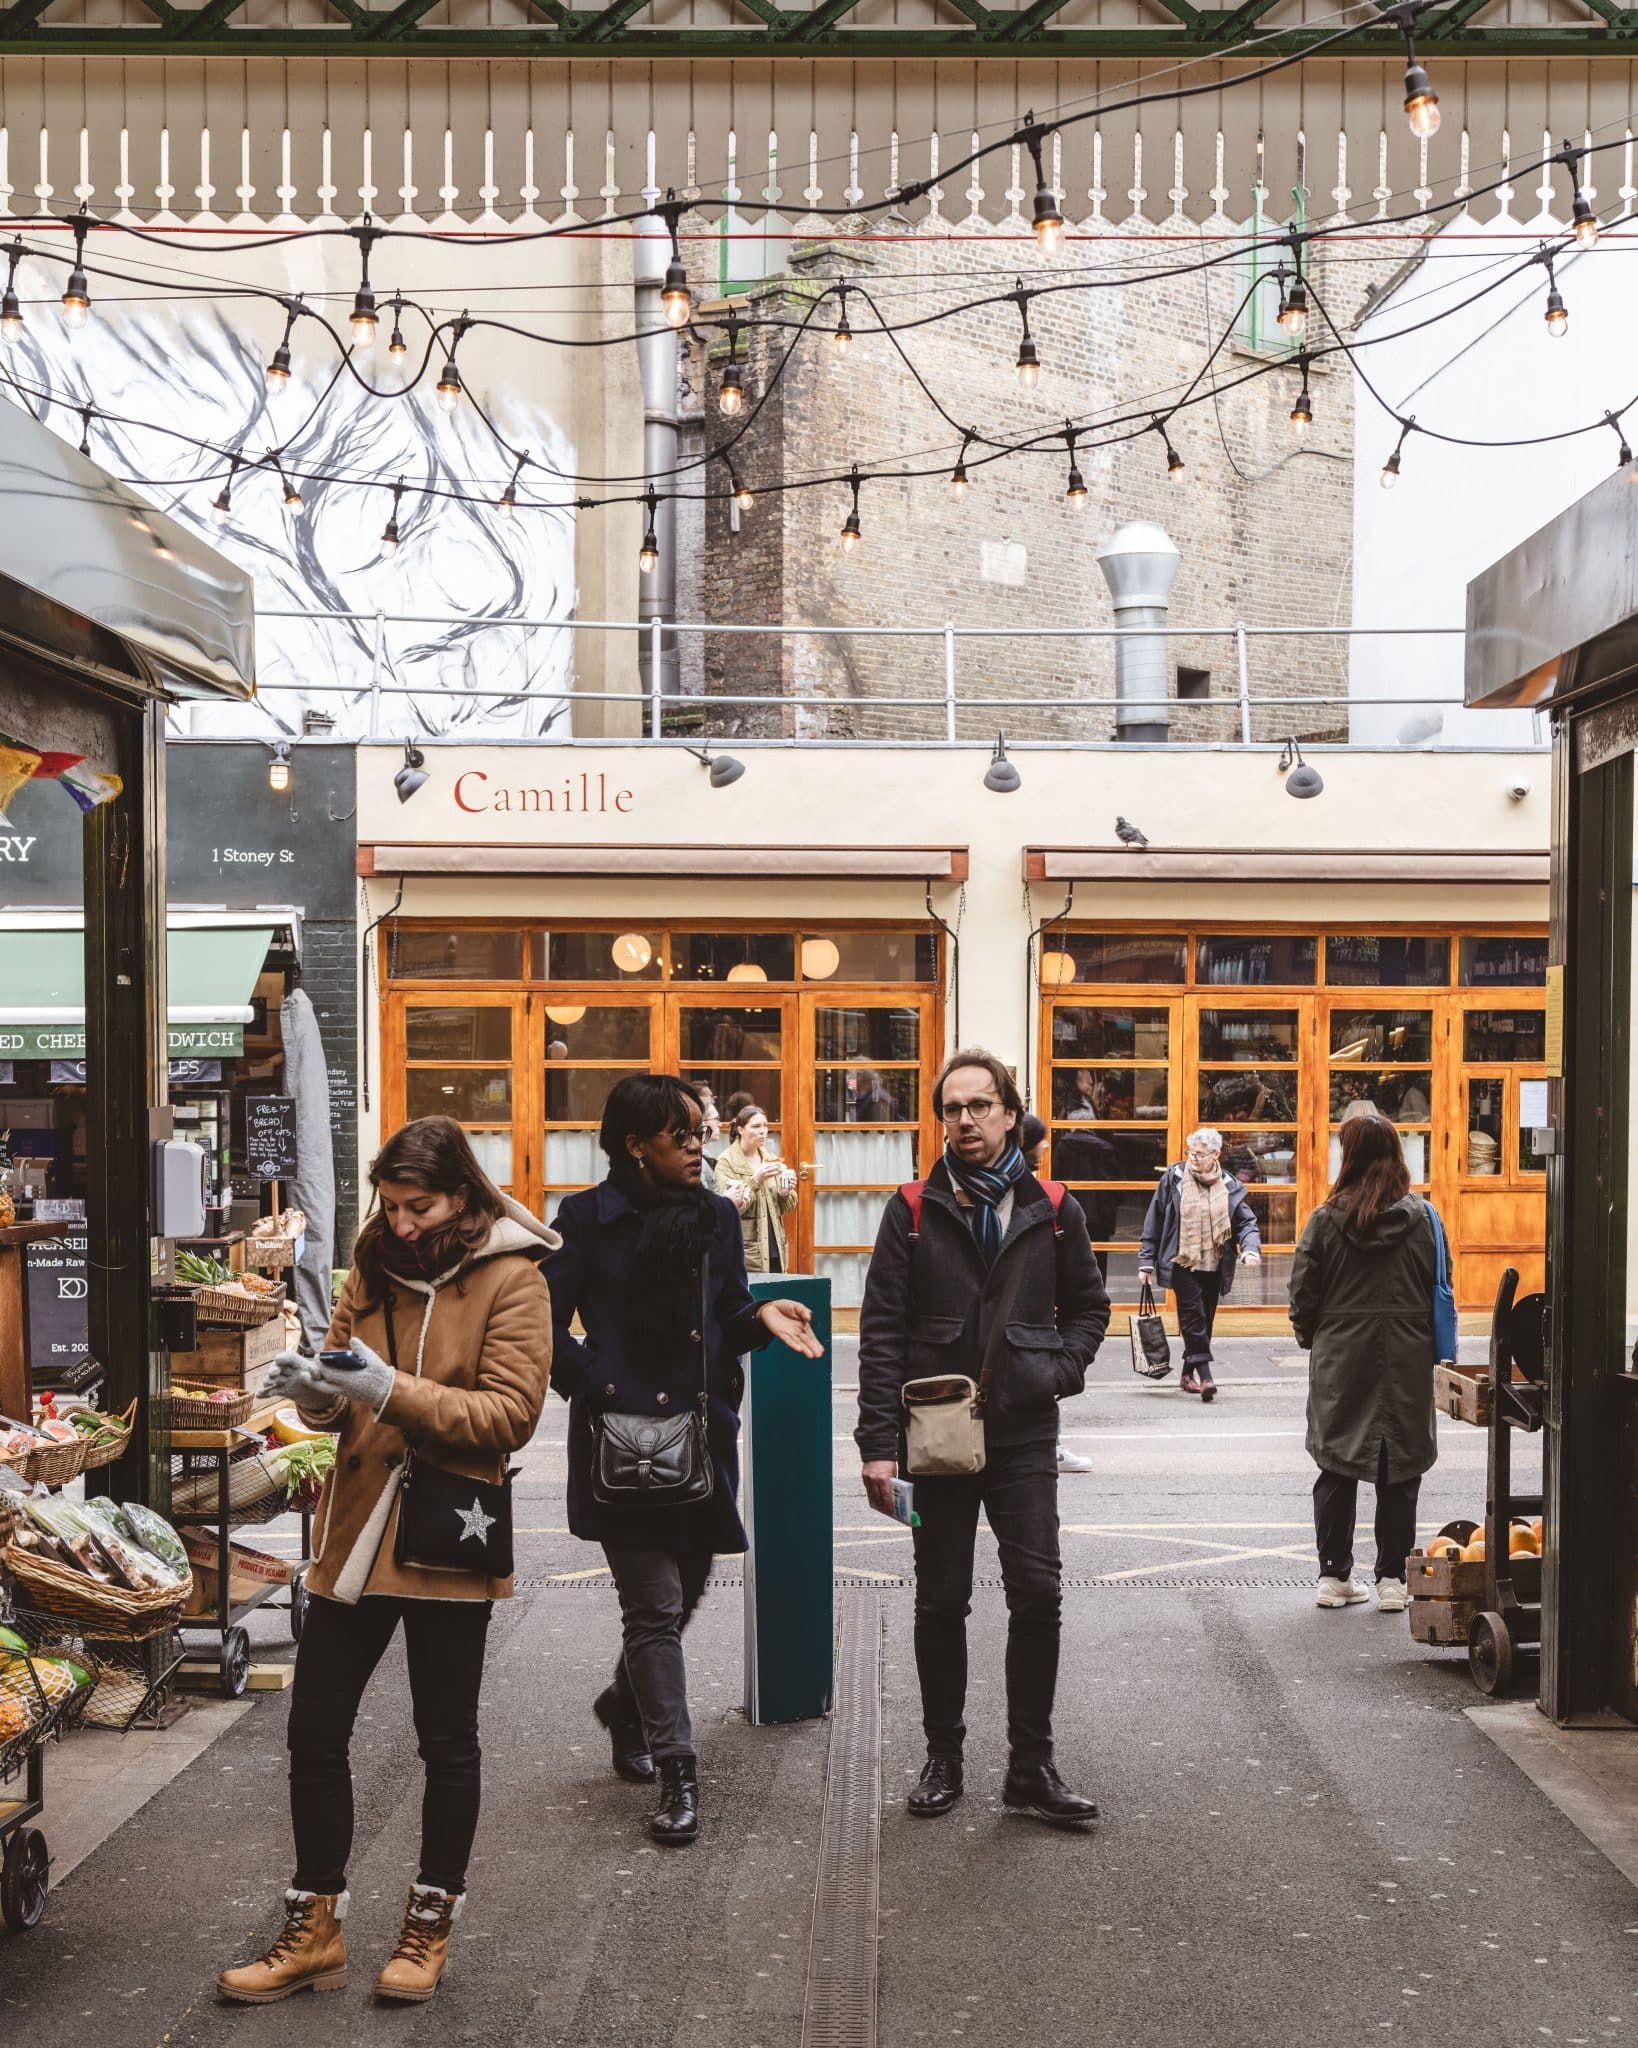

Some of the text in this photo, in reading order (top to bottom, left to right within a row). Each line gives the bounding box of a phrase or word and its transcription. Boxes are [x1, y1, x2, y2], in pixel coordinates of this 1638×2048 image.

[454, 771, 633, 813] Camille
[212, 847, 295, 867] 1 Stoney St
[168, 1031, 235, 1047] DWICH
[256, 1104, 278, 1115] FREE
[253, 1117, 281, 1128] BREAD
[65, 1259, 86, 1268] Raw
[51, 1343, 69, 1353] Est.
[237, 1560, 259, 1573] PRODUCE
[265, 1566, 287, 1577] UGANDA
